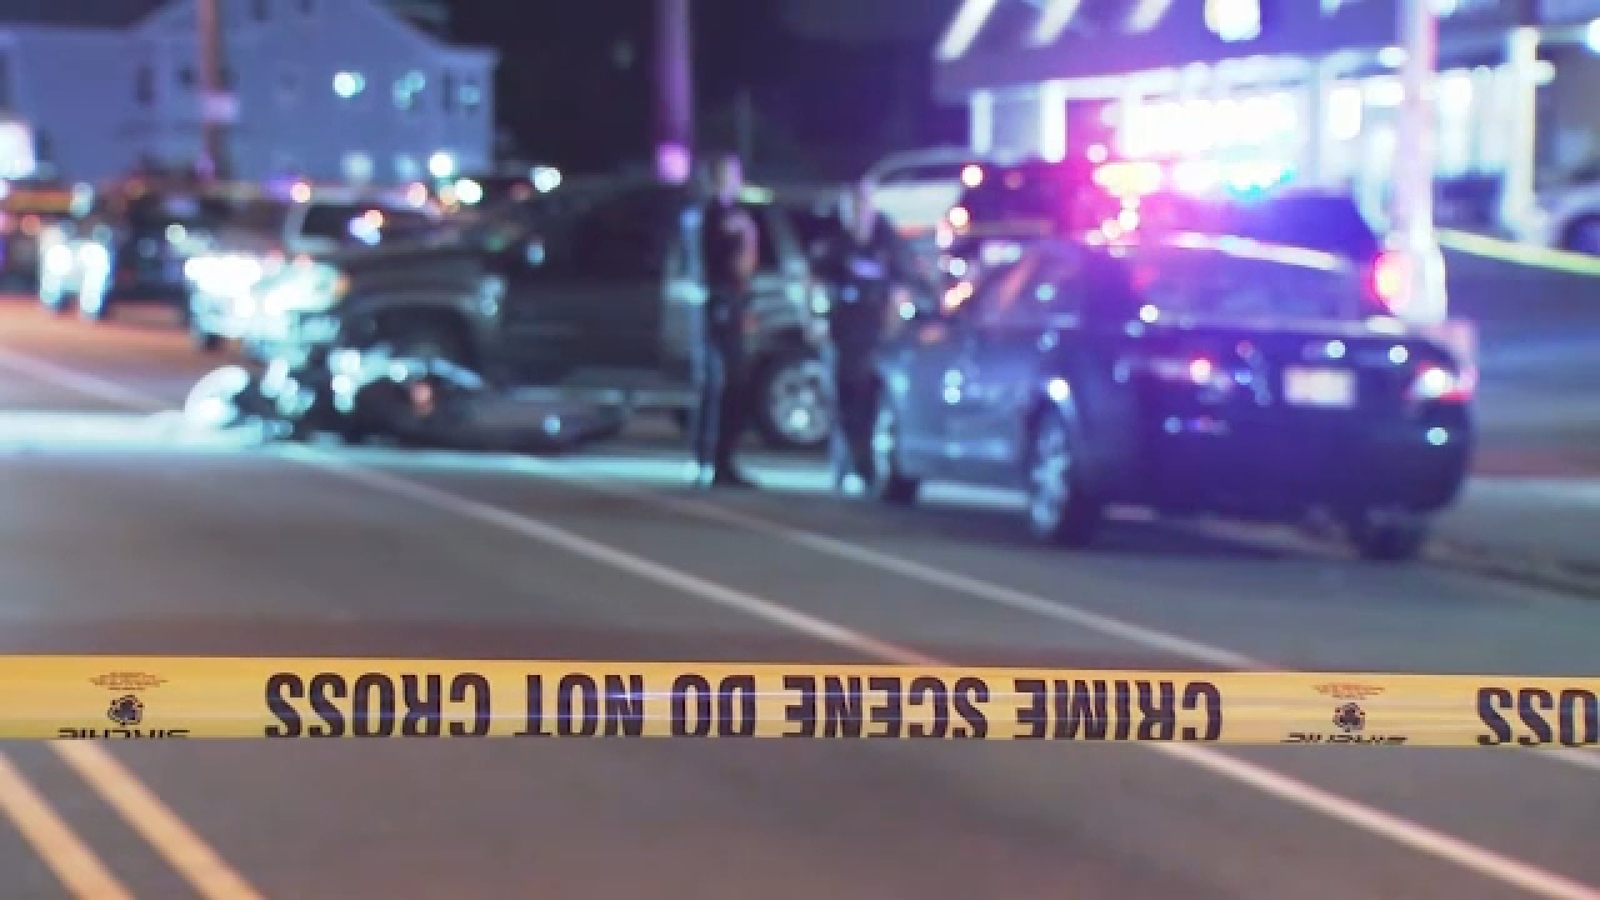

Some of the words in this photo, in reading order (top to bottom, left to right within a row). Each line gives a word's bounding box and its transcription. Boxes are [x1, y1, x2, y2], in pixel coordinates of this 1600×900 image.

[264, 672, 492, 738] CROSS
[514, 674, 644, 738] NOT
[671, 674, 756, 738] DO
[782, 675, 991, 739] SCENE
[1012, 679, 1222, 741] CRIME
